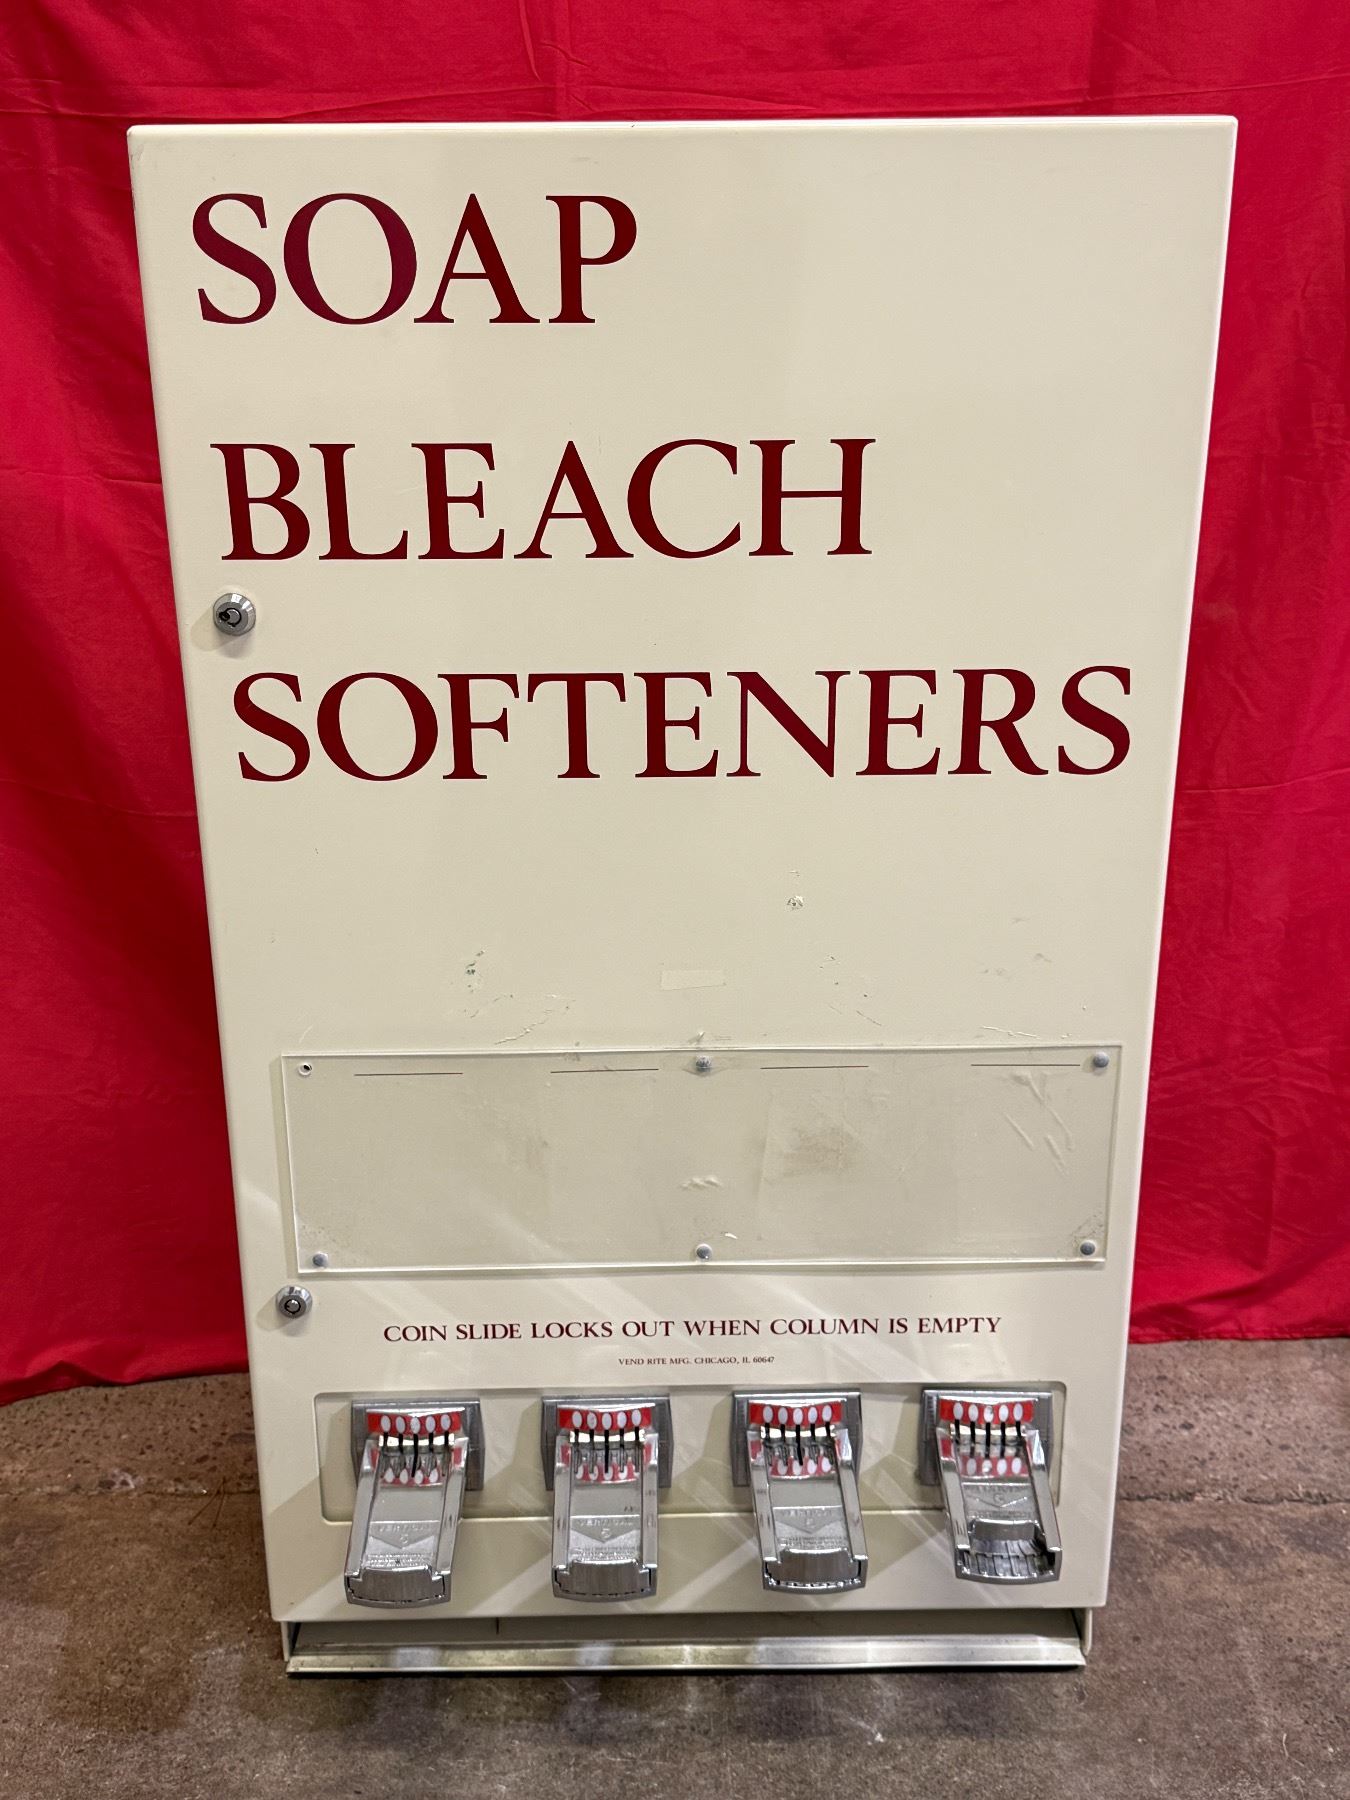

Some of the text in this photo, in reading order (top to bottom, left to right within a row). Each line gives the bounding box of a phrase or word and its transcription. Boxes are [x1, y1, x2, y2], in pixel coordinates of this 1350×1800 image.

[193, 193, 637, 324] SOAP
[210, 439, 876, 560] BLEACH
[234, 666, 1130, 782] SOFTENERS
[383, 1317, 1002, 1342] COIN SLIDE LOCKS OUT WHEN COLUMN IS EMPTY
[618, 1358, 645, 1366] VEND
[694, 1356, 740, 1366] CHICAGO,
[742, 1356, 751, 1364] IL
[752, 1356, 775, 1364] 60647
